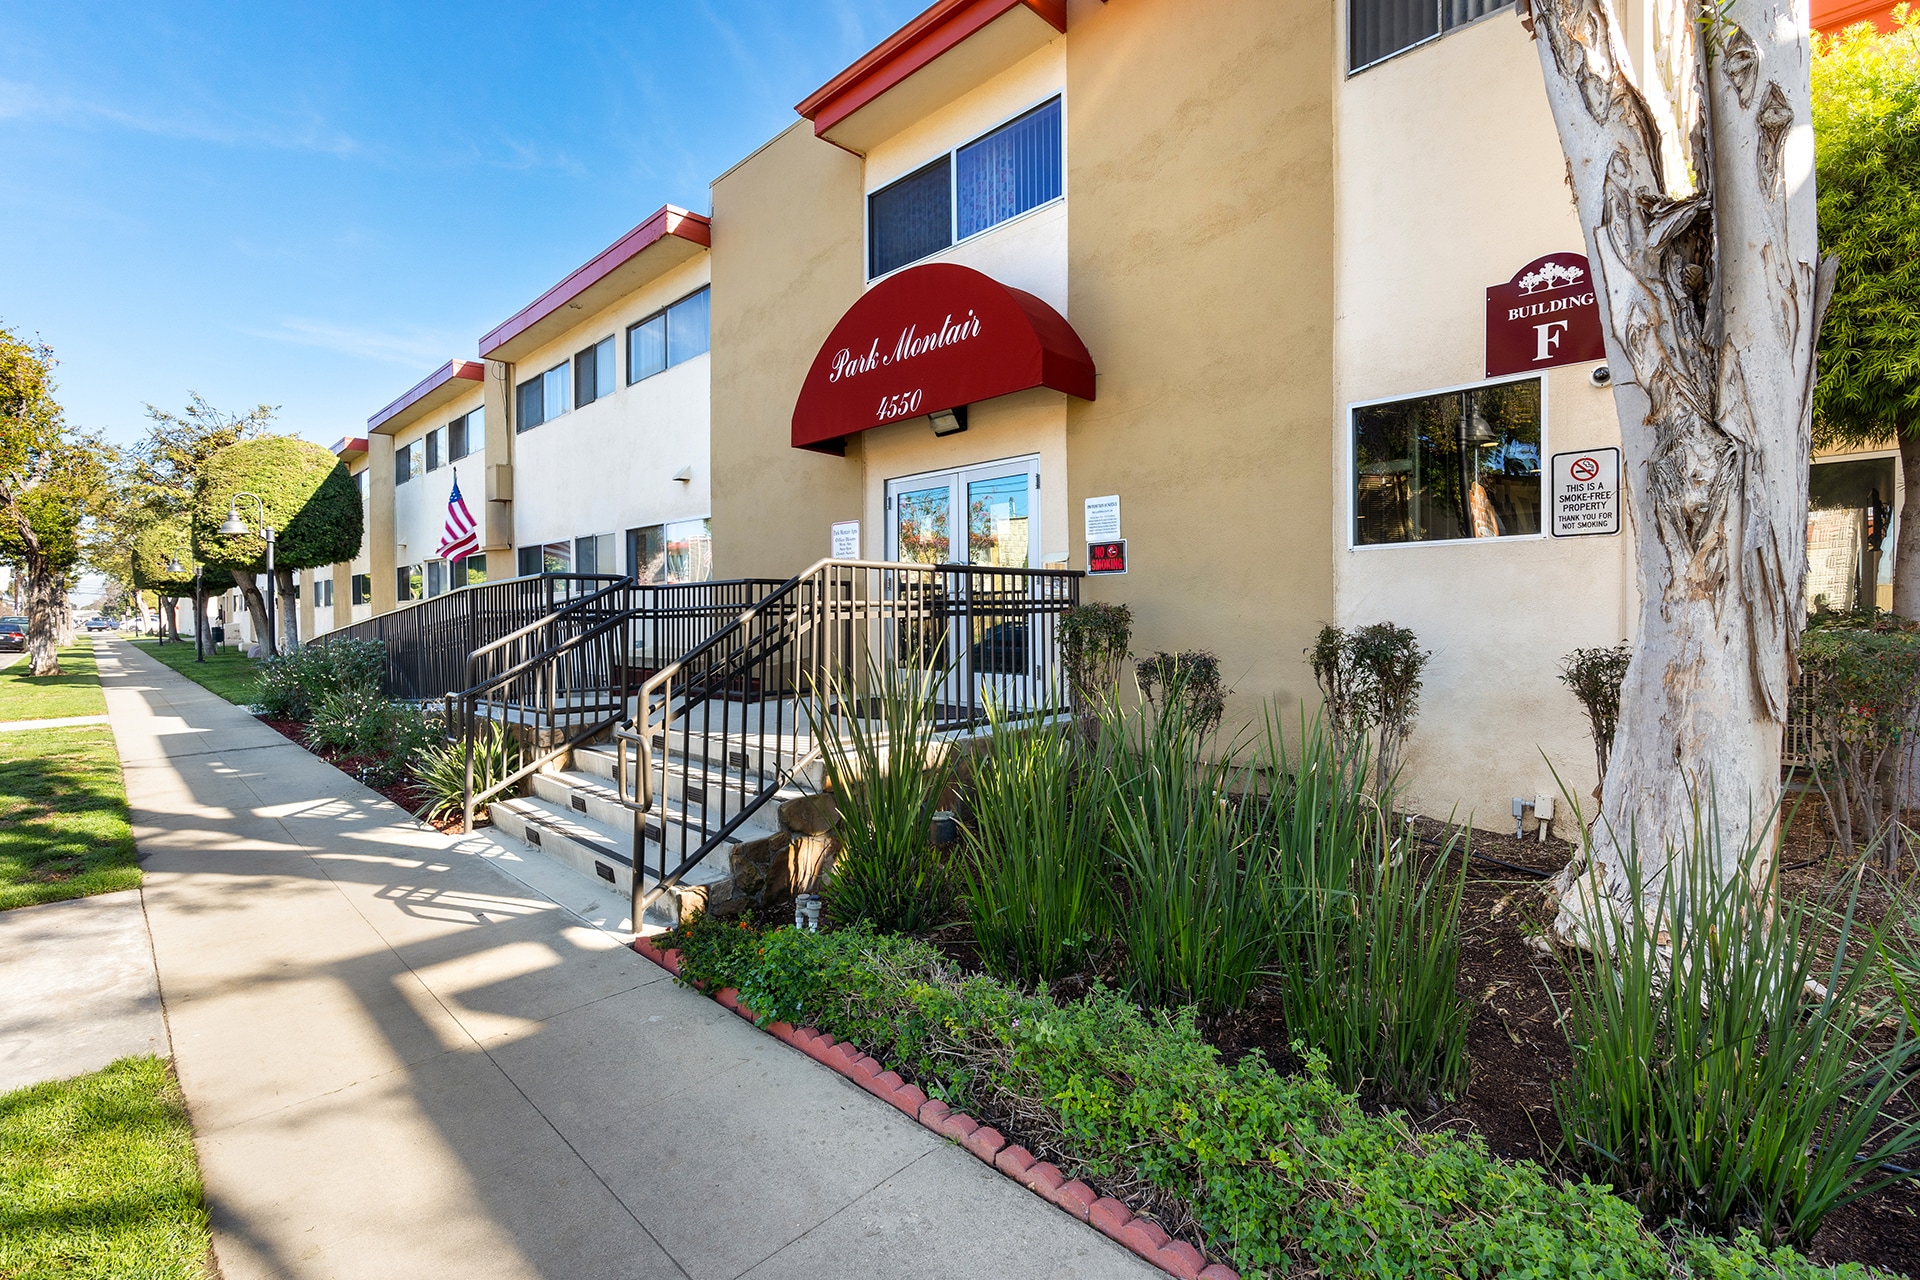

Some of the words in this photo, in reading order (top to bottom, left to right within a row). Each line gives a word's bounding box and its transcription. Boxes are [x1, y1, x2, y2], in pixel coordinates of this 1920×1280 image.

[1507, 292, 1595, 321] BUILDING
[829, 337, 880, 383] Park
[882, 309, 982, 366] Montair
[1532, 319, 1568, 361] F
[876, 388, 923, 420] 4550
[1566, 484, 1584, 492] THIS
[1587, 482, 1595, 491] IS
[1598, 482, 1604, 490] A
[1559, 491, 1612, 503] SMOKE-FREE
[1563, 501, 1607, 512] PROPERTY
[1558, 514, 1580, 522] THANK
[1582, 513, 1596, 521] YOU
[1598, 512, 1613, 520] FOR
[1562, 522, 1575, 530] NOT
[1577, 520, 1608, 529] SMOKING
[1094, 546, 1105, 558] NO
[1091, 557, 1123, 571] SMOKING
